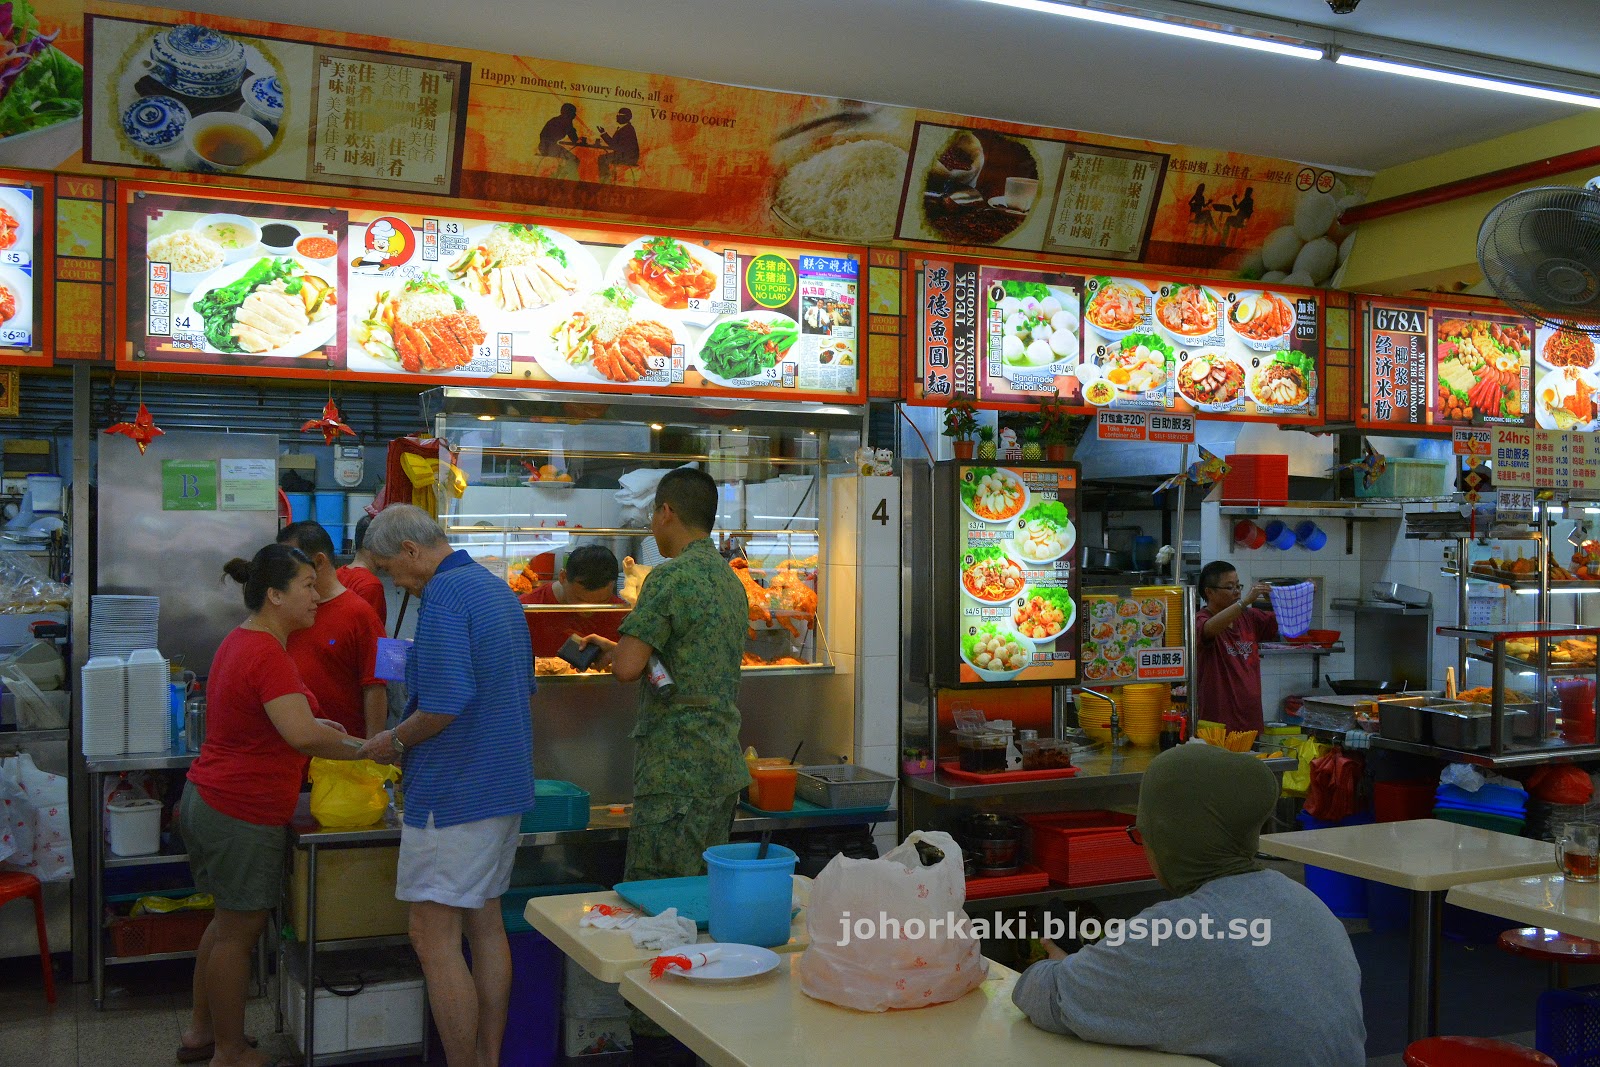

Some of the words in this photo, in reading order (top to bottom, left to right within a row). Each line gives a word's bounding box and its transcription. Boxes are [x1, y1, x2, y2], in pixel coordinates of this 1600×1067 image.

[329, 62, 344, 94] 美味
[480, 68, 517, 85] Happy
[520, 75, 567, 92] moment,
[570, 80, 612, 98] savoury
[615, 86, 645, 102] foods,
[647, 90, 661, 103] all
[663, 93, 675, 104] at
[650, 108, 667, 122] V6
[670, 112, 699, 125] FOOD
[701, 115, 738, 129] COURT
[66, 182, 95, 197] V6
[446, 223, 459, 235] $3
[7, 253, 20, 263] $5
[875, 252, 895, 266] V6
[63, 259, 96, 271] FOOD
[755, 259, 787, 271] 无猪肉
[59, 269, 101, 280] COURT
[755, 271, 787, 283] 无猪油
[755, 284, 767, 292] NO
[769, 285, 787, 293] PORK
[755, 292, 767, 300] NO
[769, 293, 787, 301] LARD
[954, 273, 968, 327] TECK
[966, 271, 976, 327] NOODLE
[689, 300, 700, 310] $2
[1297, 300, 1316, 315] 加料
[175, 316, 190, 329] $4
[1377, 309, 1424, 333] 678A
[172, 333, 208, 343] Chicken
[172, 341, 190, 349] Rice
[1410, 336, 1418, 359] HOON
[480, 346, 491, 357] $3
[654, 358, 665, 369] $3
[954, 336, 967, 393] HONG
[966, 330, 976, 395] FISHBALL
[767, 368, 777, 379] $3
[1410, 360, 1418, 378] BEE
[1418, 352, 1426, 386] LEMAK
[1013, 373, 1054, 384] Handmade
[1375, 334, 1393, 421] 经济米粉
[1395, 346, 1409, 408] 椰浆饭
[1038, 383, 1057, 393] Soup
[1410, 379, 1418, 424] ECONOMIC
[1418, 387, 1426, 405] NASI
[1152, 417, 1193, 431] 自助服务
[1104, 432, 1129, 440] container
[1123, 427, 1138, 435] Away
[1154, 433, 1189, 441] SELF-SERVICE
[1498, 430, 1531, 445] 24hrs
[1498, 448, 1530, 460] 自助服务
[179, 474, 201, 499] B
[872, 498, 889, 526] 4
[969, 521, 984, 531] $3/4
[1055, 561, 1070, 569] $4/5
[965, 607, 980, 615] $4/5
[1142, 653, 1181, 666] 自助服务
[1144, 669, 1179, 677] SELF-SERVICE
